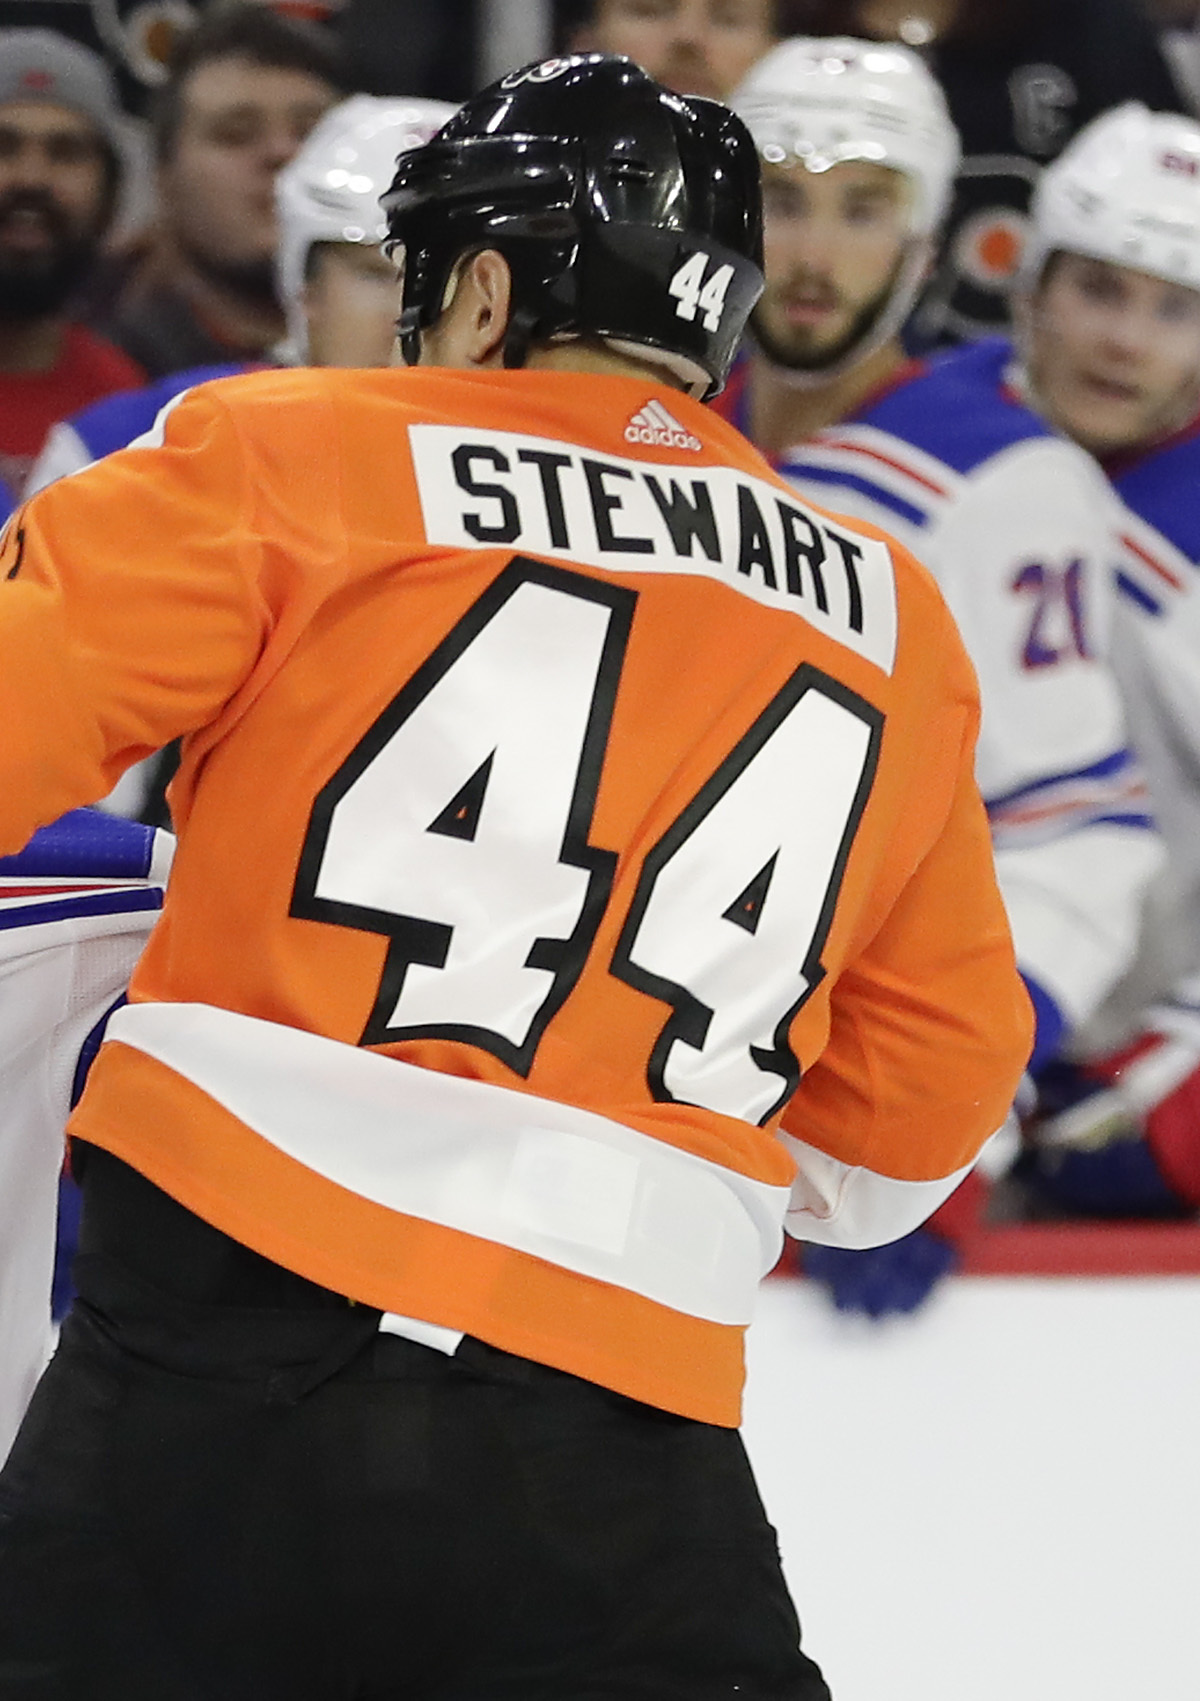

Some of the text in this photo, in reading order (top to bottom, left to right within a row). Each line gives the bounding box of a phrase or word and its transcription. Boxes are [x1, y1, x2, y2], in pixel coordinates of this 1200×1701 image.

[668, 250, 736, 333] 44
[623, 425, 703, 452] adidas
[452, 444, 866, 636] STEWART
[288, 556, 886, 1128] 44
